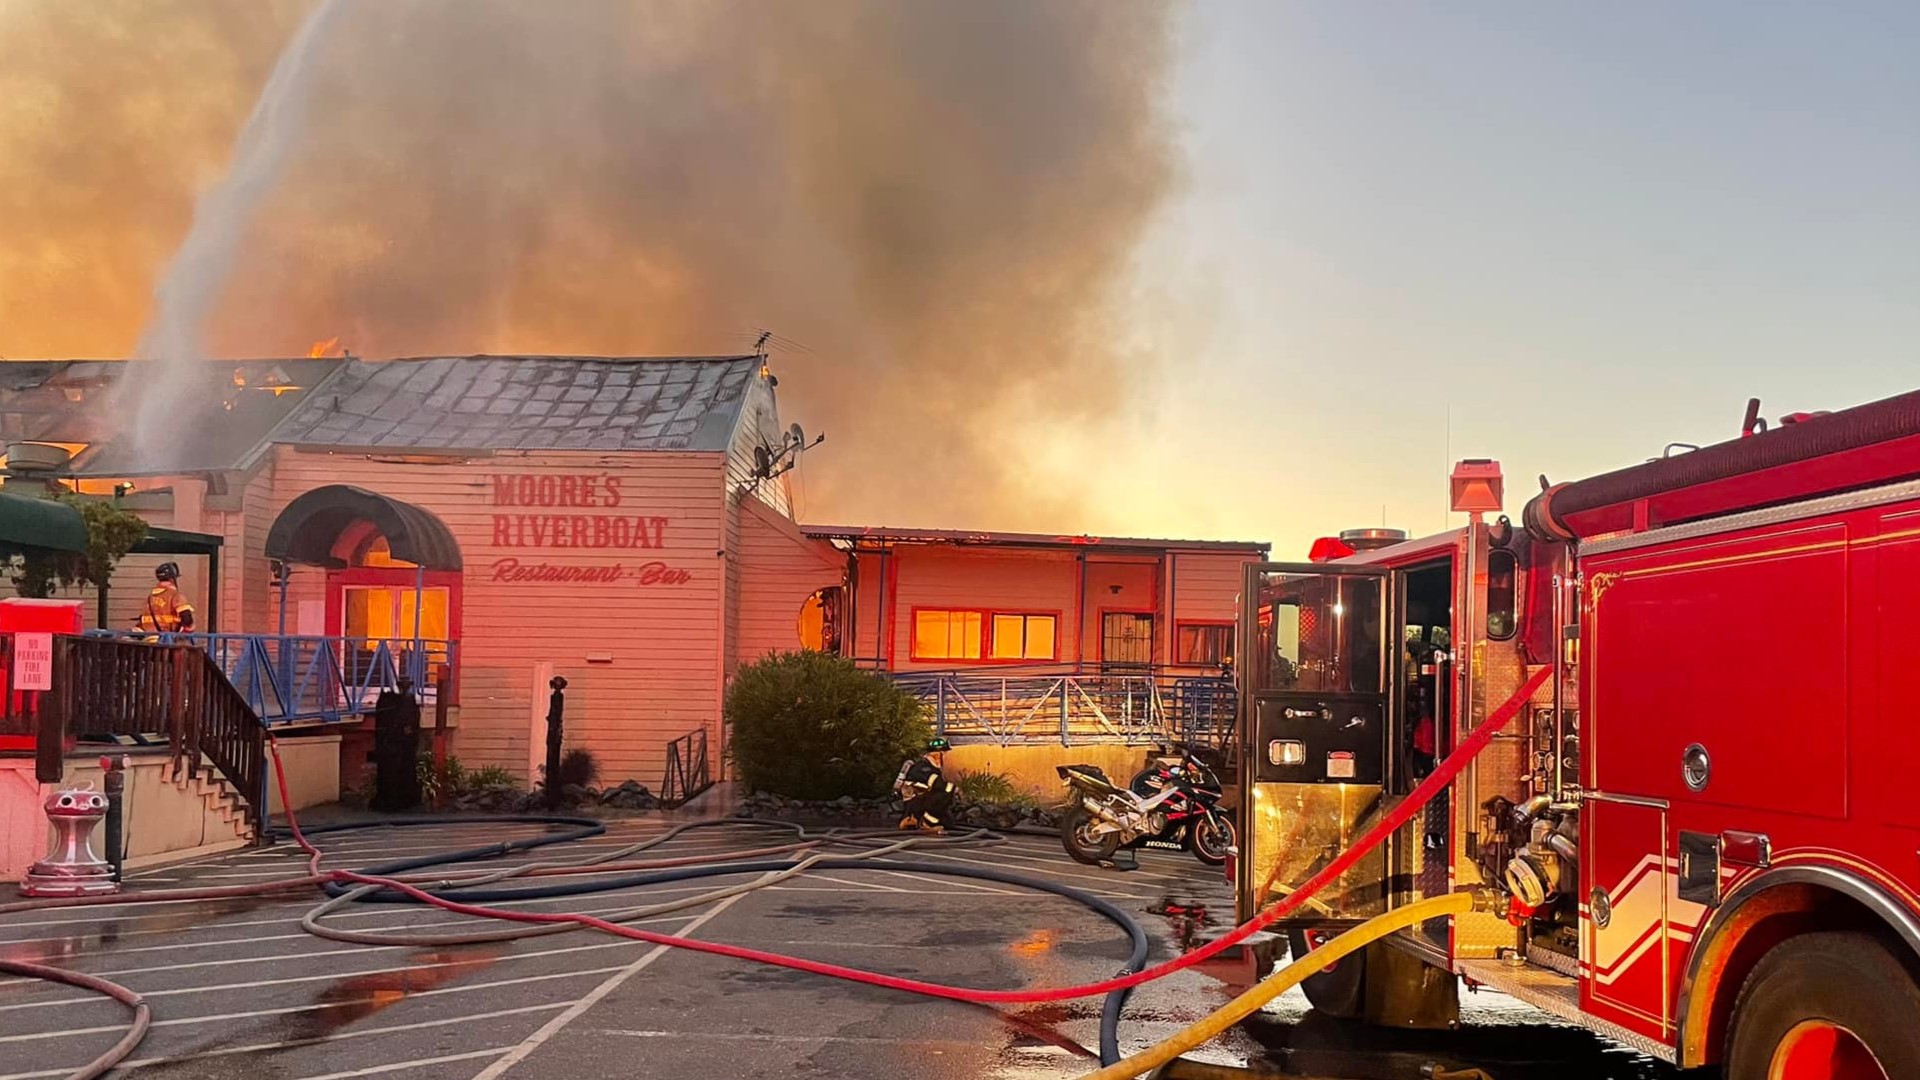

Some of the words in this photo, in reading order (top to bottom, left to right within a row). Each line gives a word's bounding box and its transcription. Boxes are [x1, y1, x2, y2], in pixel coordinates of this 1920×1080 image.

[492, 514, 668, 549] RIVERBOAT
[492, 558, 622, 583] Restaurant
[639, 562, 691, 586] Bar
[28, 639, 39, 649] NO
[17, 651, 49, 661] PARKING
[25, 662, 40, 672] FIRE
[23, 673, 42, 683] LANE
[1145, 841, 1182, 849] HONDA
